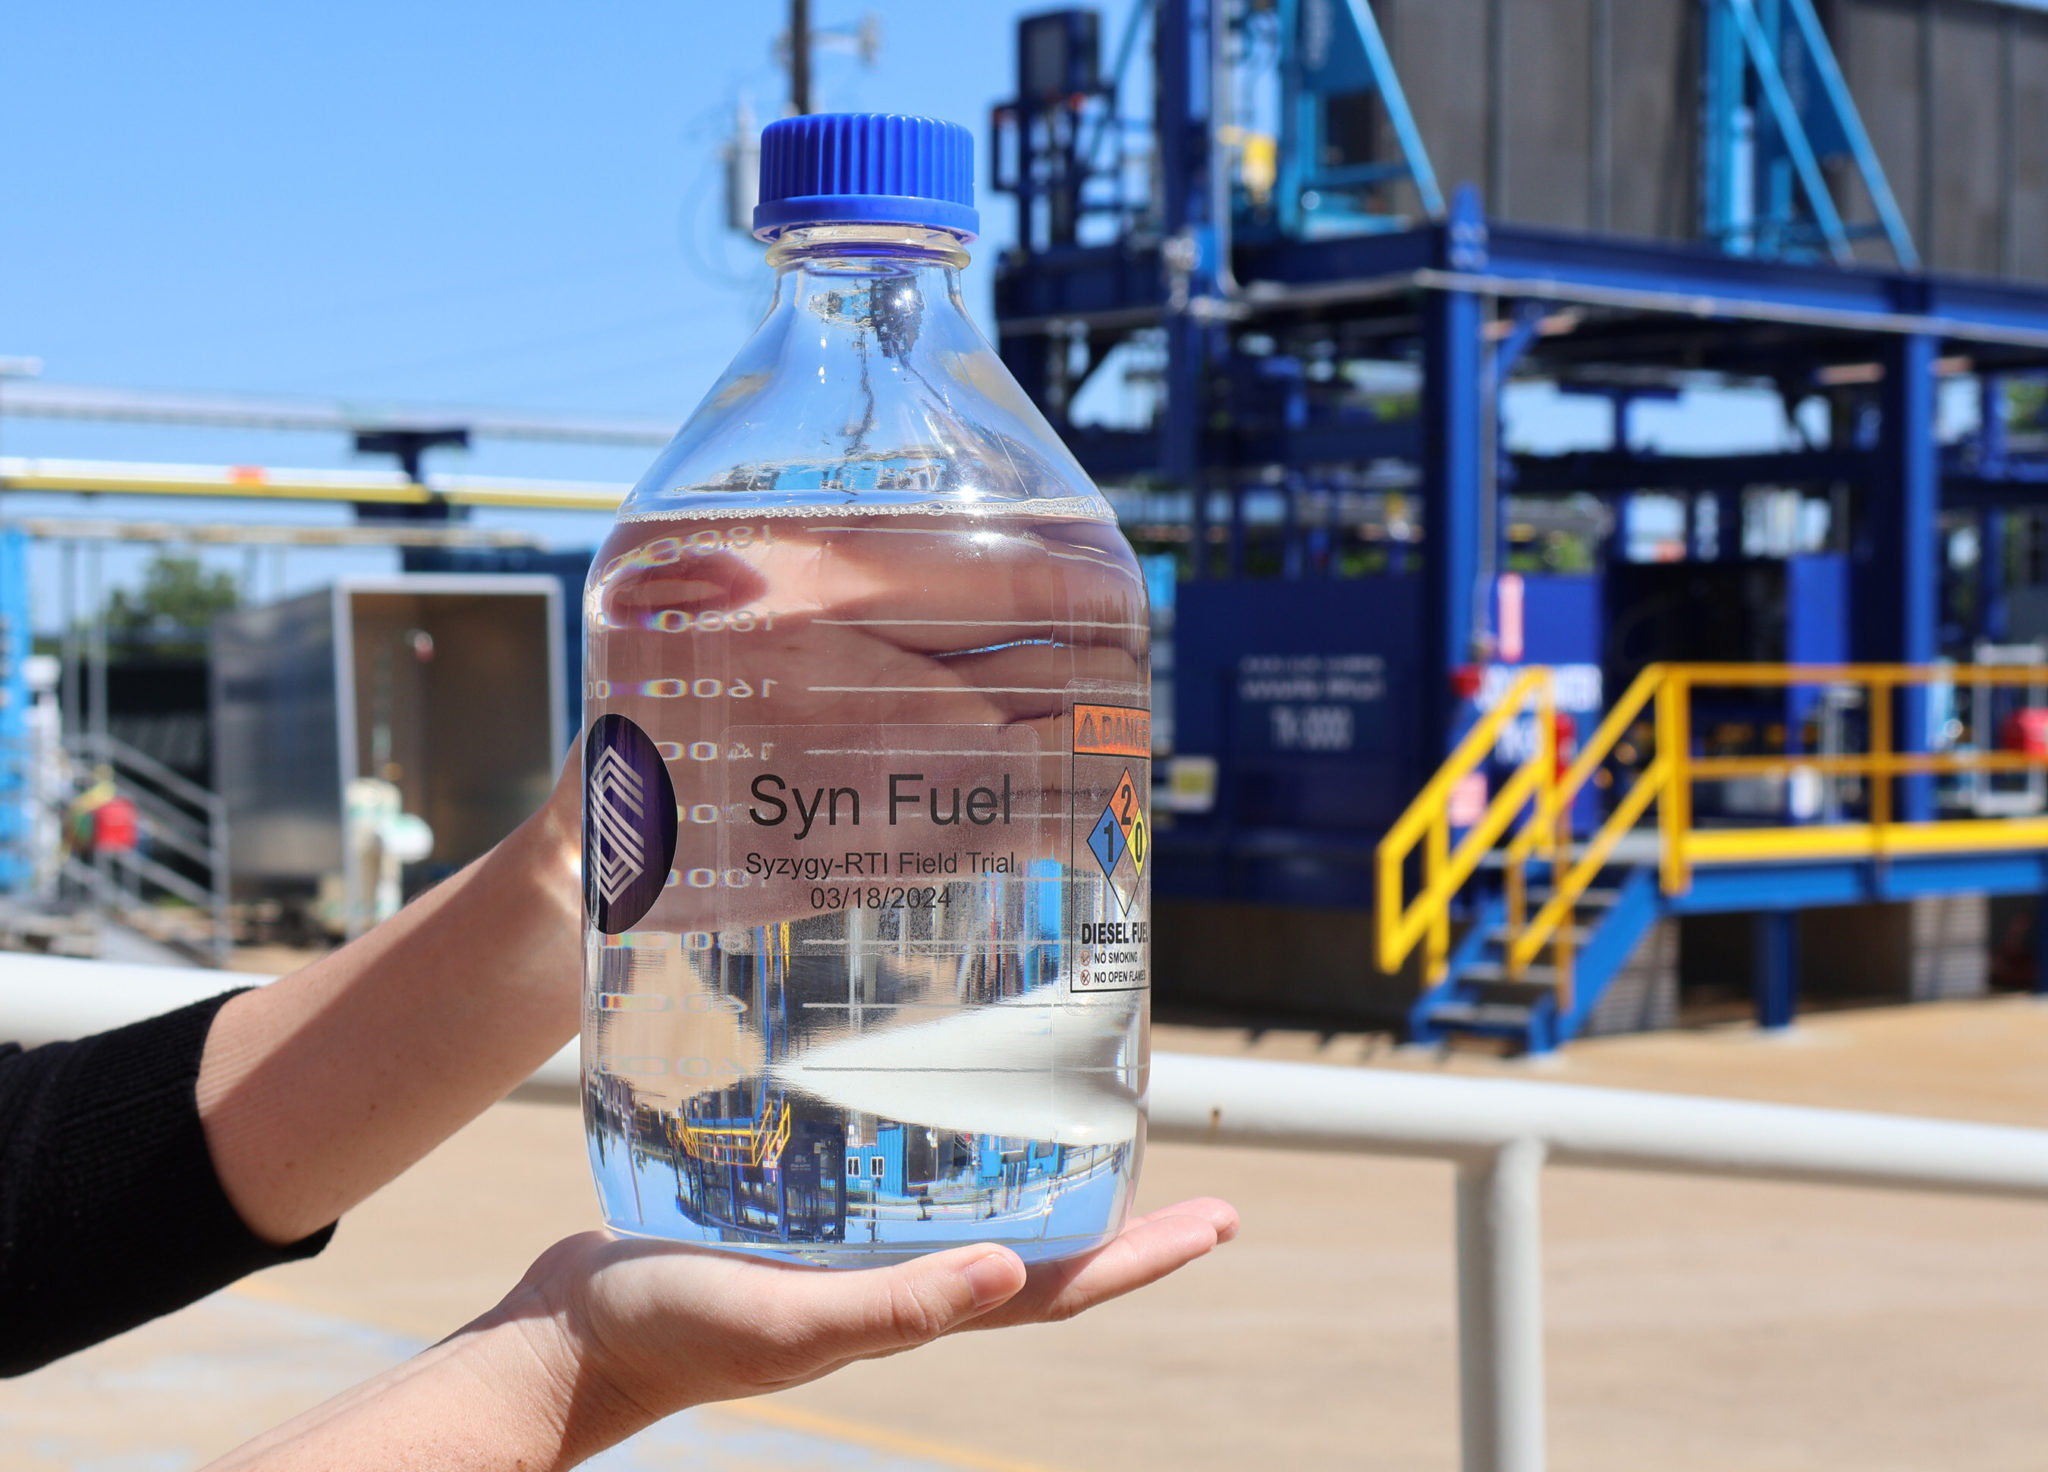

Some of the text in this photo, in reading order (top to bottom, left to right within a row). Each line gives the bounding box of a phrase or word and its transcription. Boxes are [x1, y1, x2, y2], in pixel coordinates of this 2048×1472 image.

[1102, 715, 1150, 748] DANGE
[750, 774, 1010, 840] Syn Fuel
[1121, 784, 1131, 825] 2
[1104, 821, 1114, 862] 1
[1136, 822, 1143, 863] 0
[746, 852, 888, 880] Syzygy-RTI
[900, 852, 957, 874] Field
[966, 852, 1014, 873] Trial
[811, 887, 951, 909] 03/18/2024
[1082, 922, 1129, 944] DIESEL
[1094, 951, 1138, 964] NO SMOKING
[1094, 972, 1106, 983] NO
[1108, 971, 1128, 982] OPEN
